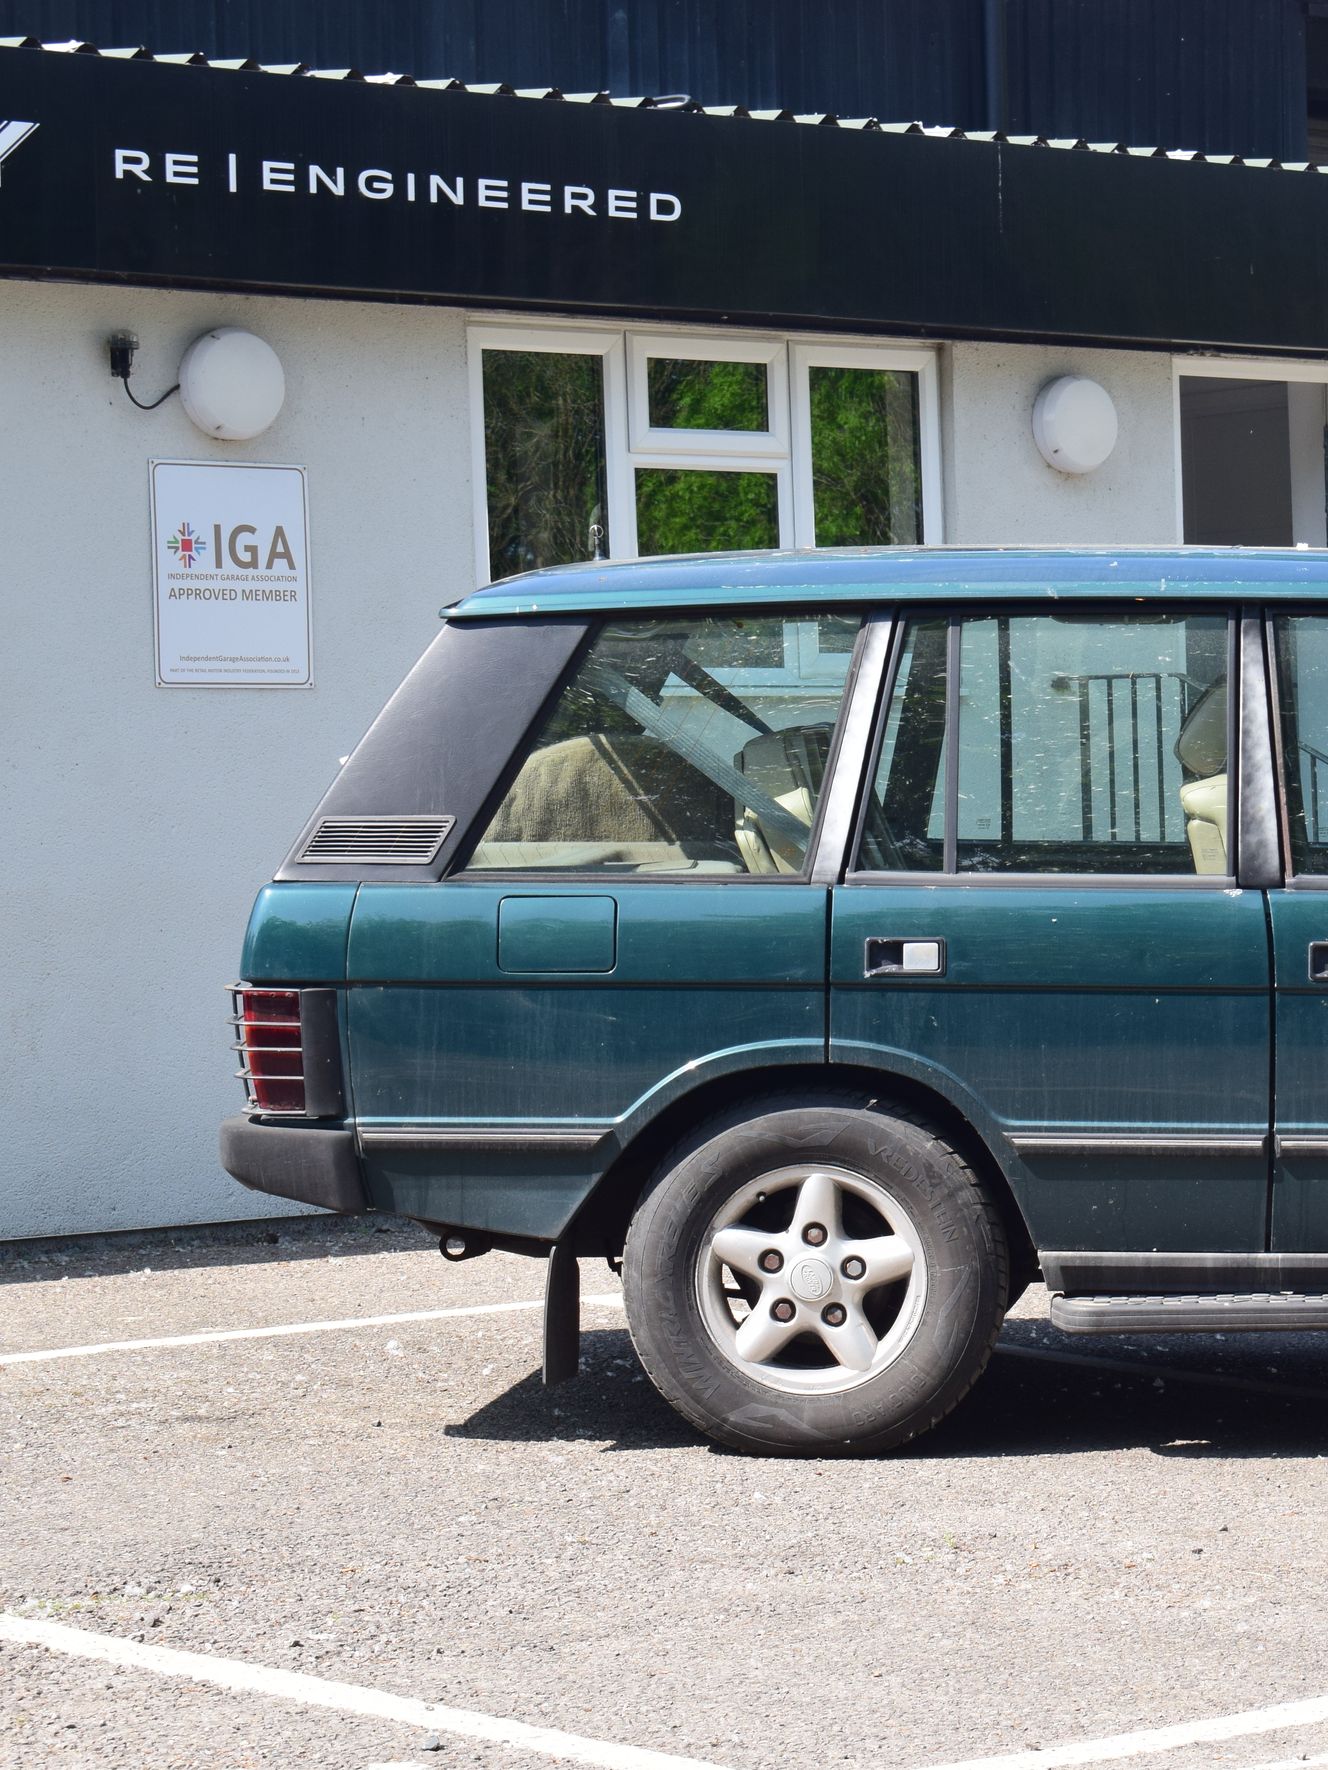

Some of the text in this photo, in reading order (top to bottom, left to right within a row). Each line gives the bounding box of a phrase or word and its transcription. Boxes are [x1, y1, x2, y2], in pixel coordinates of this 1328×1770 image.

[262, 160, 682, 222] ENGINEERED
[213, 523, 297, 570] IGA
[167, 573, 298, 583] INDEPENDENT GARAGE ASSOCIATION
[168, 587, 298, 602] APPROVED MEMBER
[179, 654, 290, 664] IndependentGarageAssociation.co.uk
